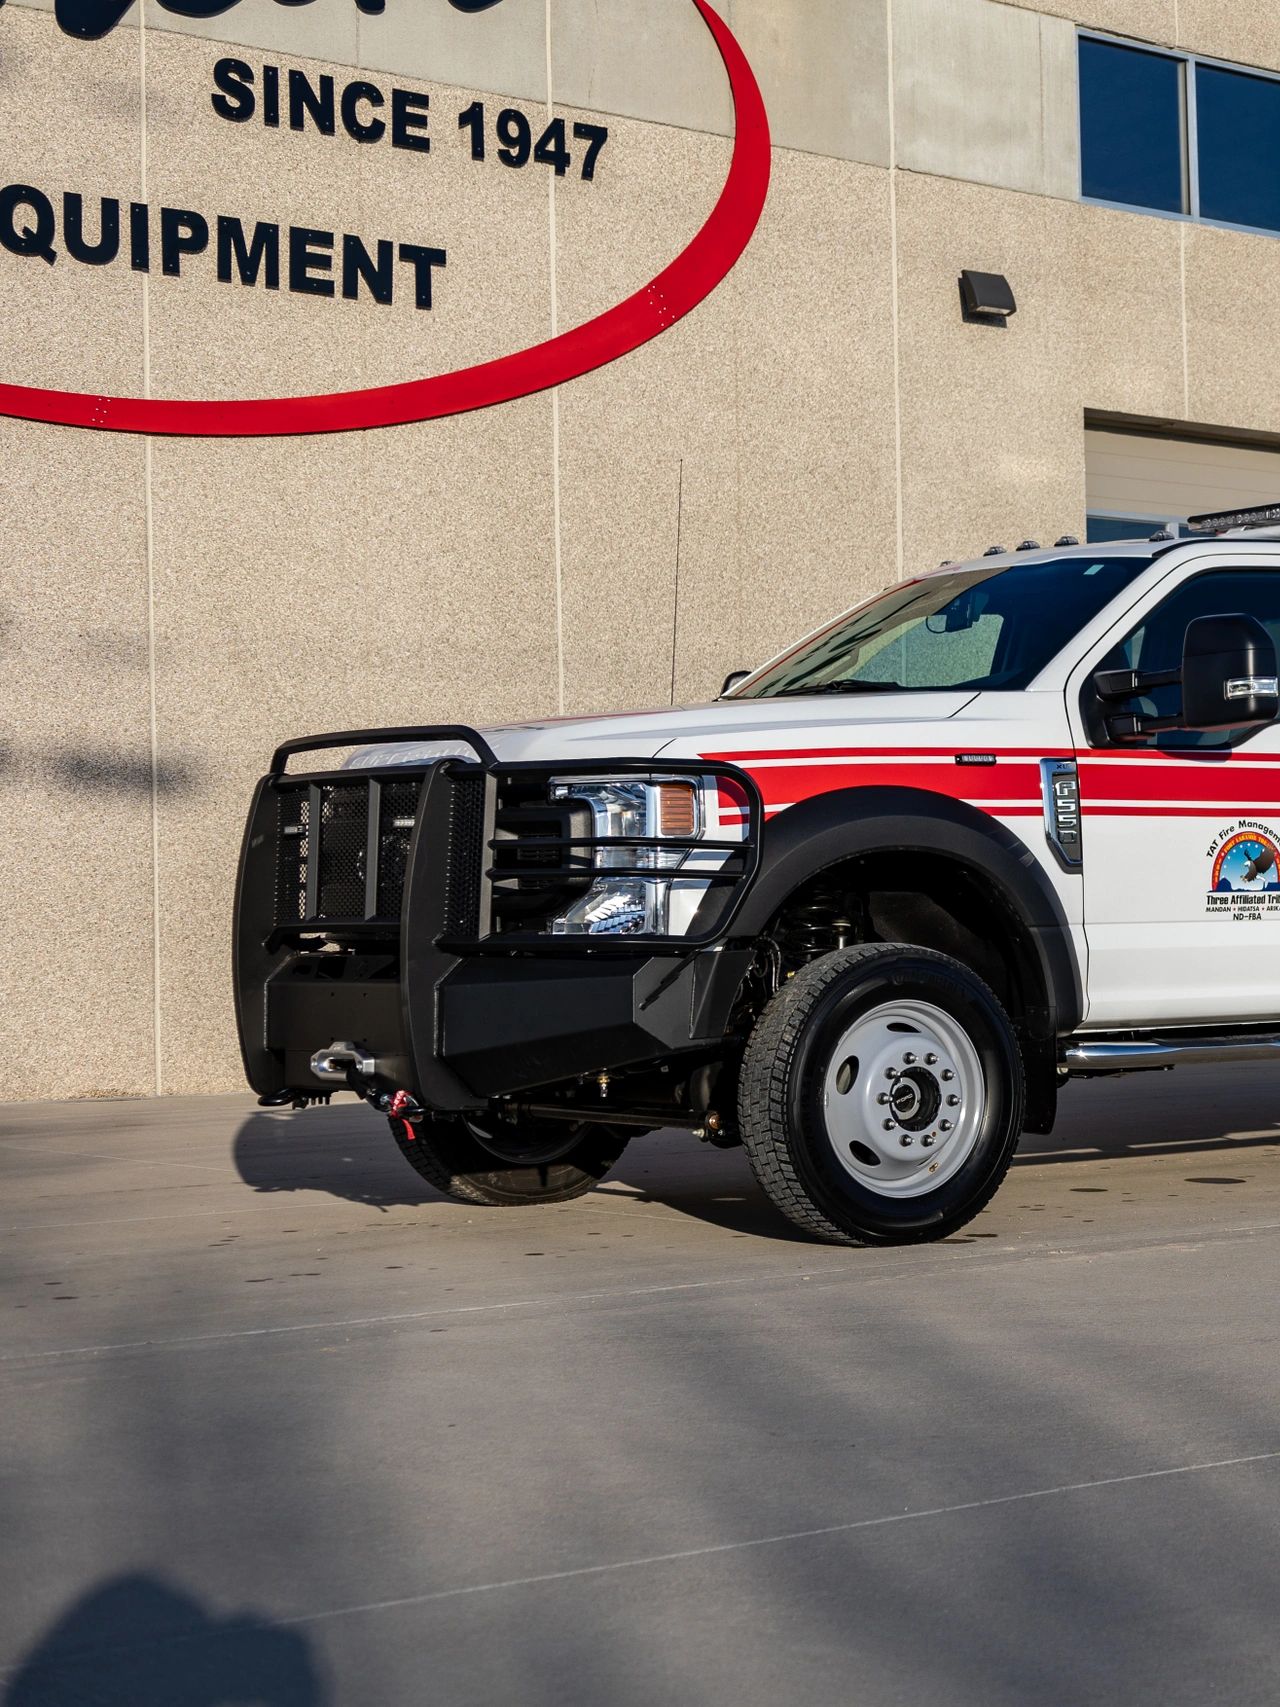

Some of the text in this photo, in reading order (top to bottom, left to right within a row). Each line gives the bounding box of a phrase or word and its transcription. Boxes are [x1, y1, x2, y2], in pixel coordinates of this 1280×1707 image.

[210, 57, 609, 182] SINCE 1947
[0, 183, 447, 311] QUIPMENT
[1206, 839, 1219, 858] TAT
[1218, 825, 1235, 840] Fire
[1206, 895, 1229, 905] Three
[1230, 894, 1266, 905] Affiliated
[1232, 912, 1262, 920] ND-FBA
